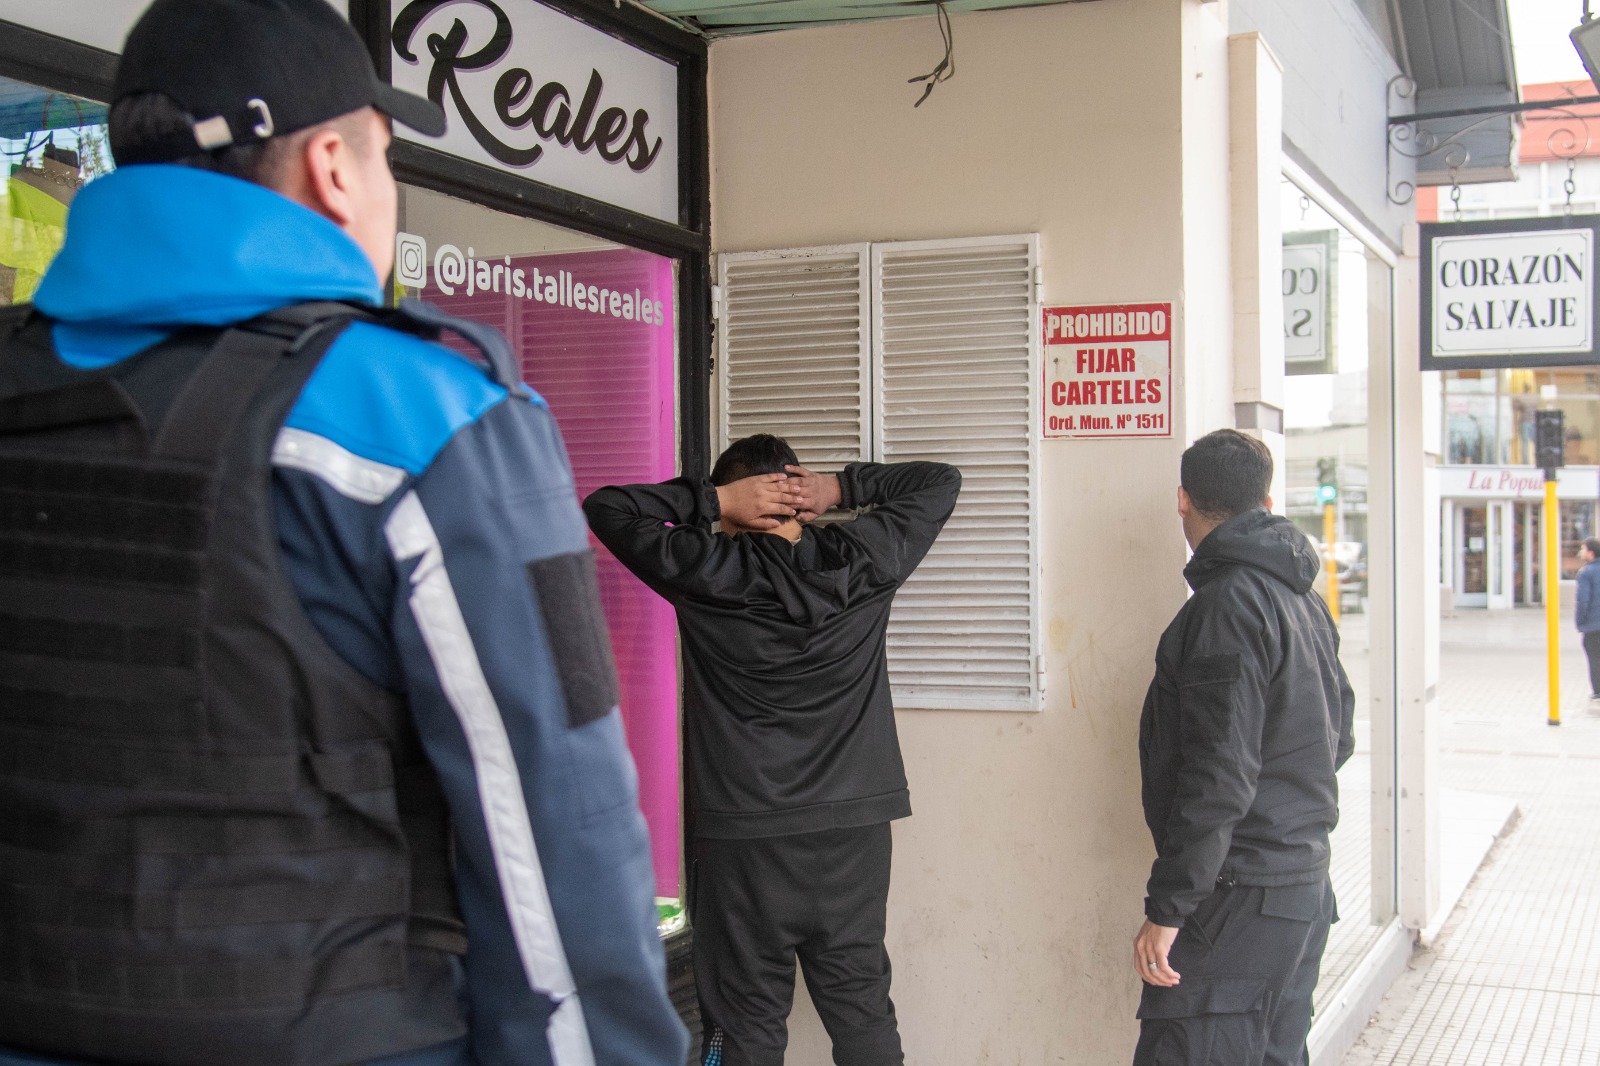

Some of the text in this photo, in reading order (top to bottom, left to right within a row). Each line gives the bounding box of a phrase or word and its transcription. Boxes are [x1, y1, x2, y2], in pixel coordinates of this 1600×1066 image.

[391, 0, 662, 173] Reales
[1440, 247, 1584, 288] CORAZÓN
[434, 244, 665, 326] @jaris.tallesreales
[1047, 310, 1166, 339] PROHIBIDO
[1445, 297, 1577, 331] SALVAJE
[1076, 348, 1136, 374] FIJAR
[1051, 378, 1162, 406] CARTELES
[1049, 415, 1077, 431] Ord.
[1080, 415, 1114, 430] Mun.
[1135, 413, 1164, 429] 1511
[1467, 470, 1492, 490] La
